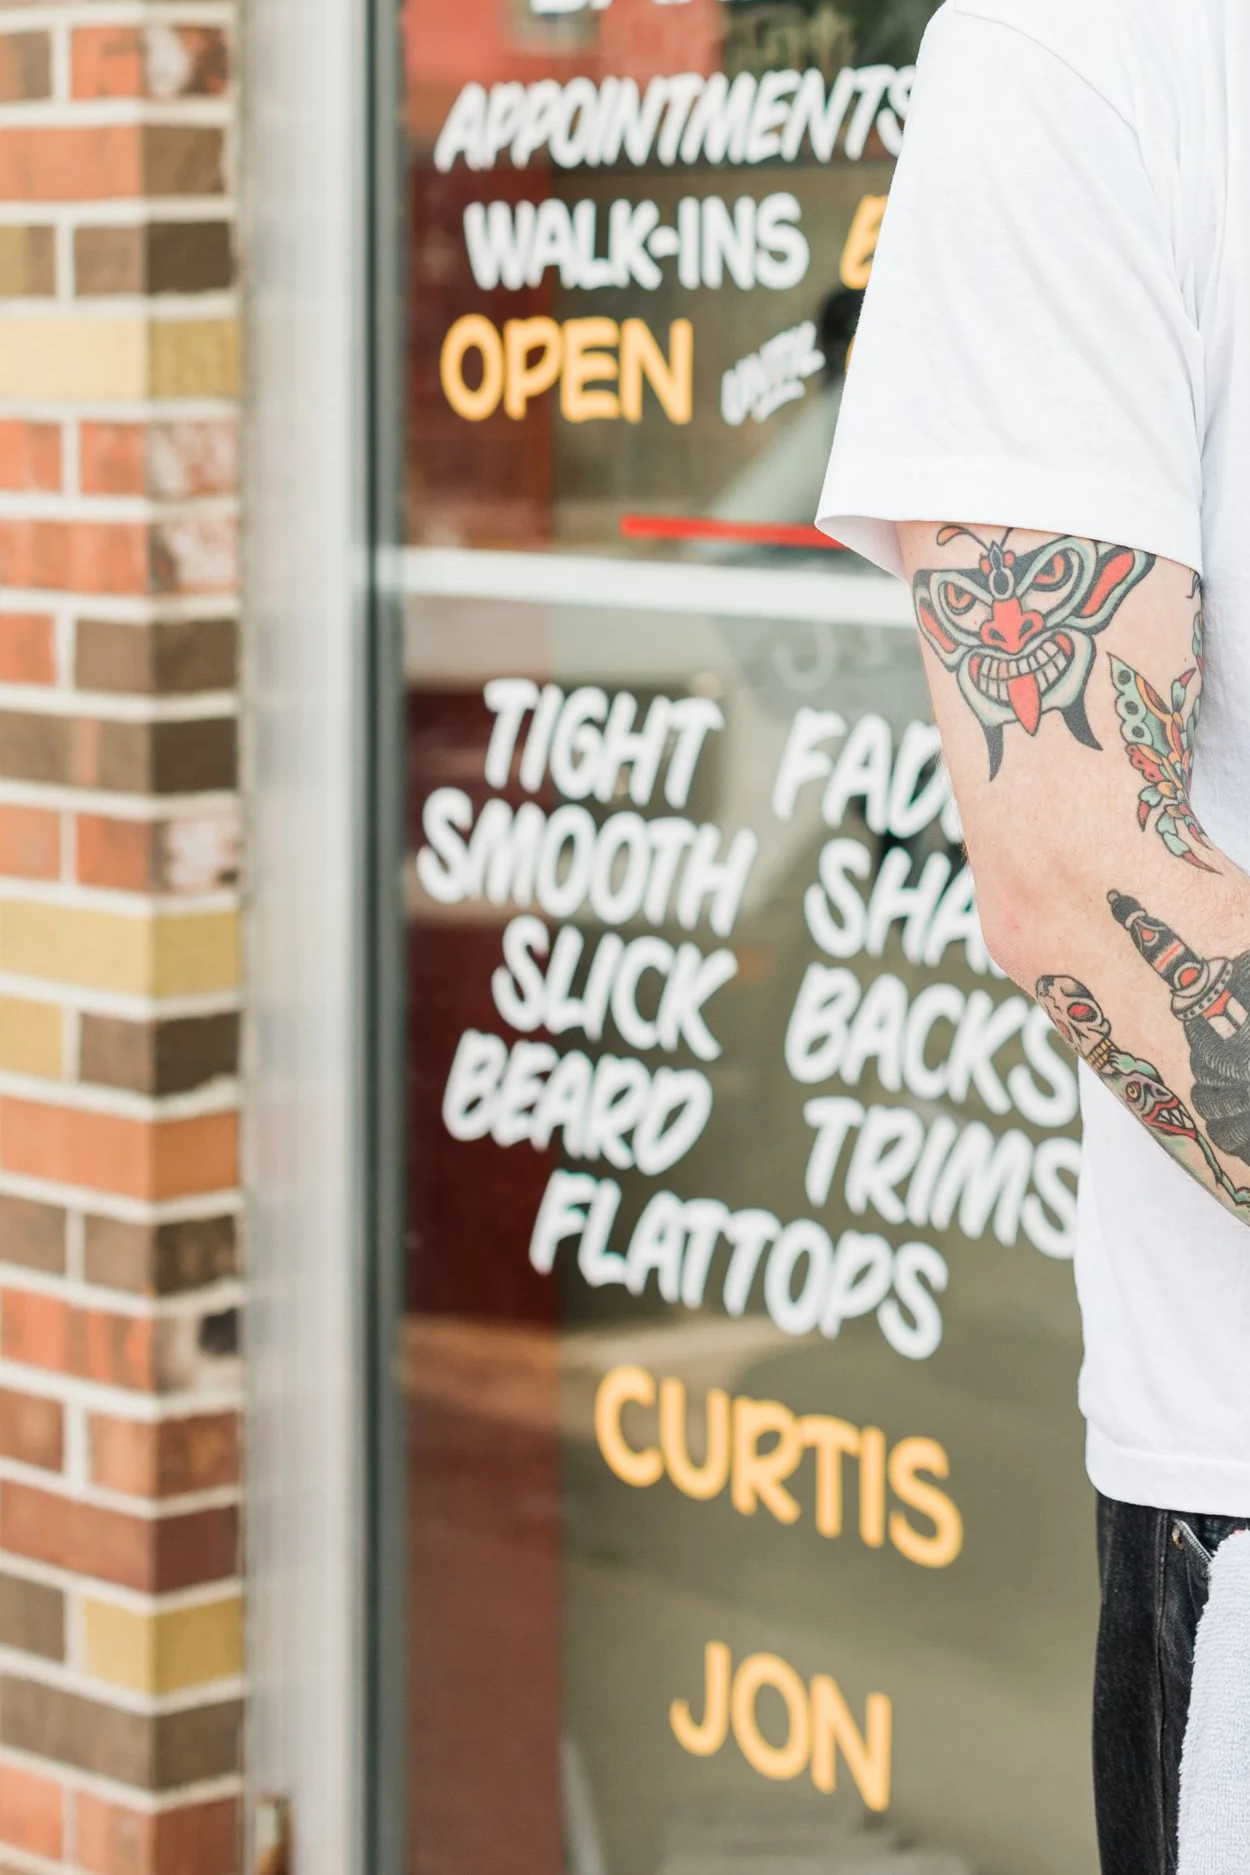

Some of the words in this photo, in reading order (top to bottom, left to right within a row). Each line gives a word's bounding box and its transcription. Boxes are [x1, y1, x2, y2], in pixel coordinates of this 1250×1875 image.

[463, 192, 810, 291] WALK-INS
[440, 314, 693, 425] OPEN
[484, 678, 724, 808] TIGHT
[770, 707, 966, 843] FAD
[417, 787, 757, 937] SMOOTH
[804, 837, 1007, 978] SHA
[491, 915, 738, 1060] SLICK
[785, 962, 1080, 1128] BACKS
[443, 1028, 713, 1176] BEARD
[803, 1096, 1084, 1260] TRIMS
[529, 1170, 948, 1360] FLATTOPS
[595, 1364, 964, 1568] CURTIS
[670, 1640, 893, 1812] JON
